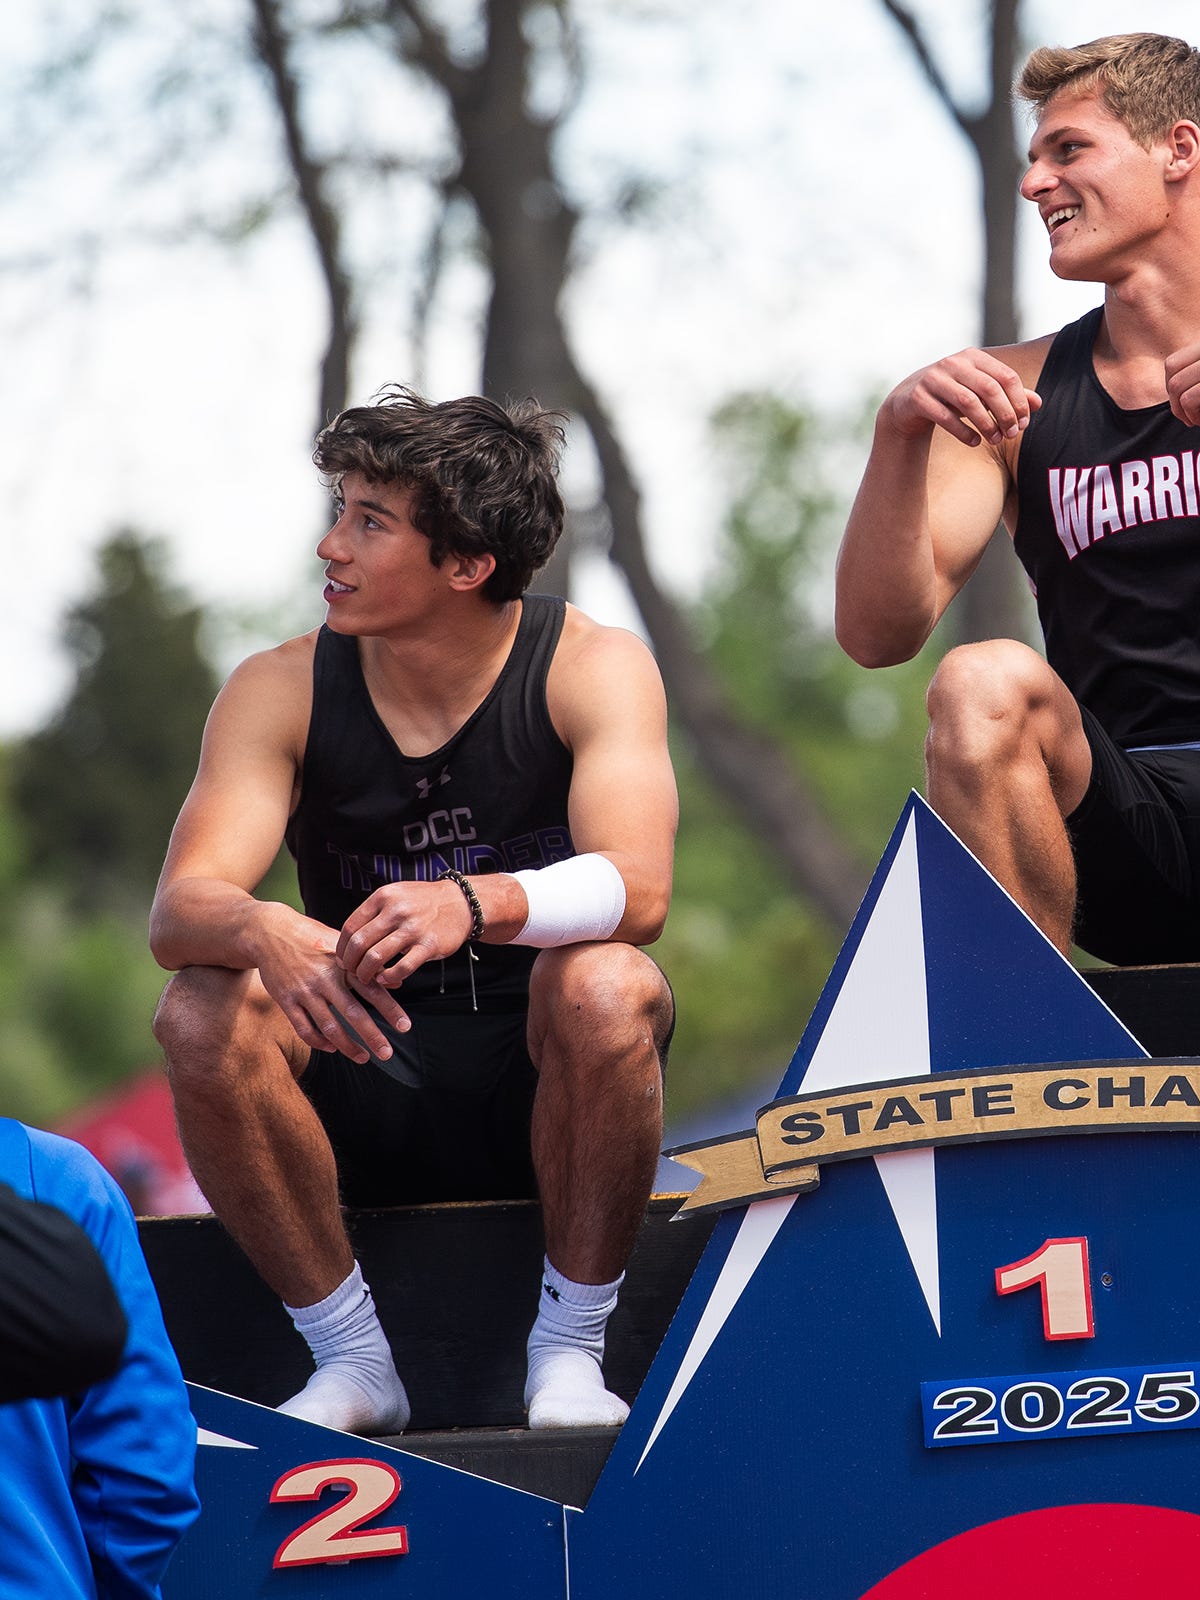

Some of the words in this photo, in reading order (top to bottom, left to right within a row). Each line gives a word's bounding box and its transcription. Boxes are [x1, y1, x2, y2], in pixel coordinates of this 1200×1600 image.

[402, 806, 477, 851] DCC
[780, 1083, 1016, 1146] STATE
[995, 1236, 1095, 1341] 1
[931, 1370, 1200, 1440] 2025
[269, 1457, 409, 1569] 2
